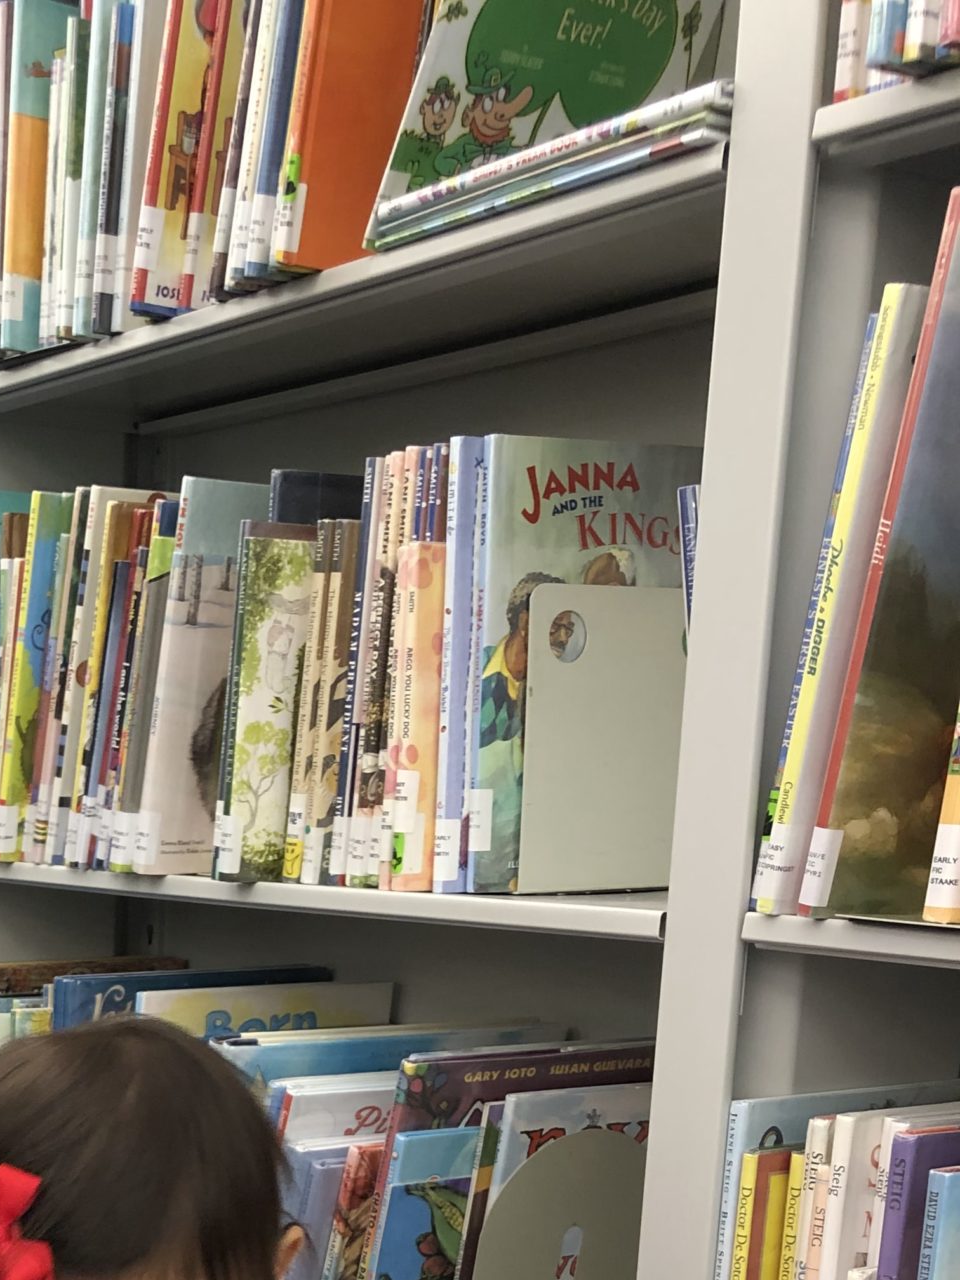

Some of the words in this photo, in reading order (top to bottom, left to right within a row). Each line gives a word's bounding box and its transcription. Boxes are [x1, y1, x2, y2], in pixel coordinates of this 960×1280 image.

[556, 7, 613, 49] Ever!
[415, 469, 424, 507] SMITH
[429, 465, 438, 504] SMITH
[521, 462, 640, 524] JANNA
[552, 498, 577, 516] AND
[581, 495, 604, 509] THE
[315, 529, 325, 562] SMITH
[332, 529, 342, 562] SMITH
[350, 591, 362, 651] MADAM
[807, 618, 826, 677] DIGGER
[405, 673, 413, 692] YOU
[116, 690, 127, 712] the
[341, 660, 356, 753] PRESIDENT
[403, 693, 412, 724] LUCKY
[111, 713, 122, 749] world
[204, 1009, 318, 1038] Born
[464, 1069, 501, 1083] GARY
[504, 1067, 536, 1079] SOTO
[550, 1062, 590, 1075] SUSAN
[728, 1112, 738, 1155] JEANNE
[828, 1165, 845, 1197] Steig
[889, 1158, 907, 1211] STEIG
[737, 1186, 753, 1231] Doctor
[785, 1186, 801, 1231] Doctor
[927, 1190, 939, 1221] DAVID
[736, 1232, 748, 1252] De
[784, 1232, 797, 1252] De
[811, 1206, 826, 1248] STEIG
[923, 1224, 935, 1249] EZRA
